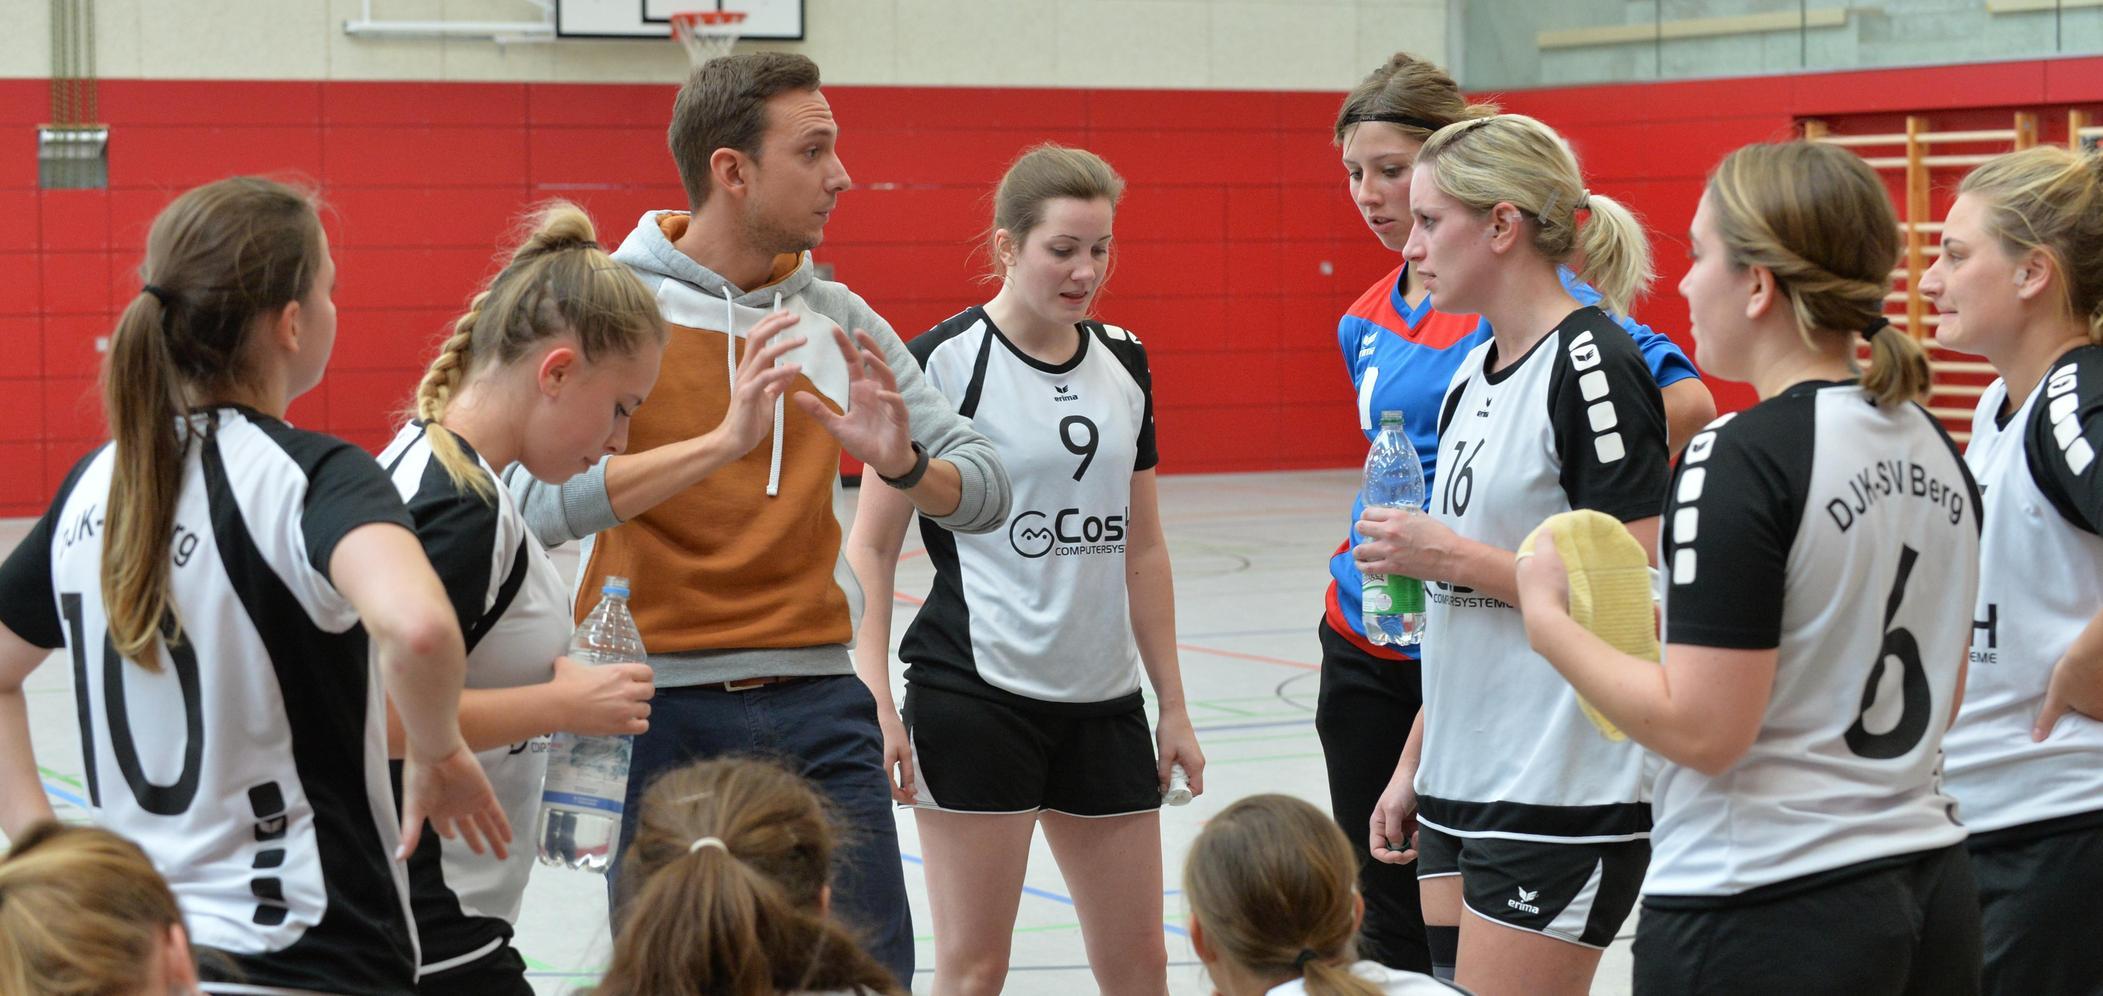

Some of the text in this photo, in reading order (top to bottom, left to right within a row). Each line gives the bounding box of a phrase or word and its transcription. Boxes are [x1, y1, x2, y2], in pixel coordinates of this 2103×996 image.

[1054, 393, 1079, 402] erima
[1059, 415, 1099, 482] 9
[1442, 438, 1485, 517] 16
[1826, 460, 1963, 532] DJK-SV Berg
[1055, 545, 1125, 556] COMPUTERSYS
[1844, 543, 1931, 760] 6
[60, 592, 205, 816] 10
[1508, 899, 1539, 914] erima
